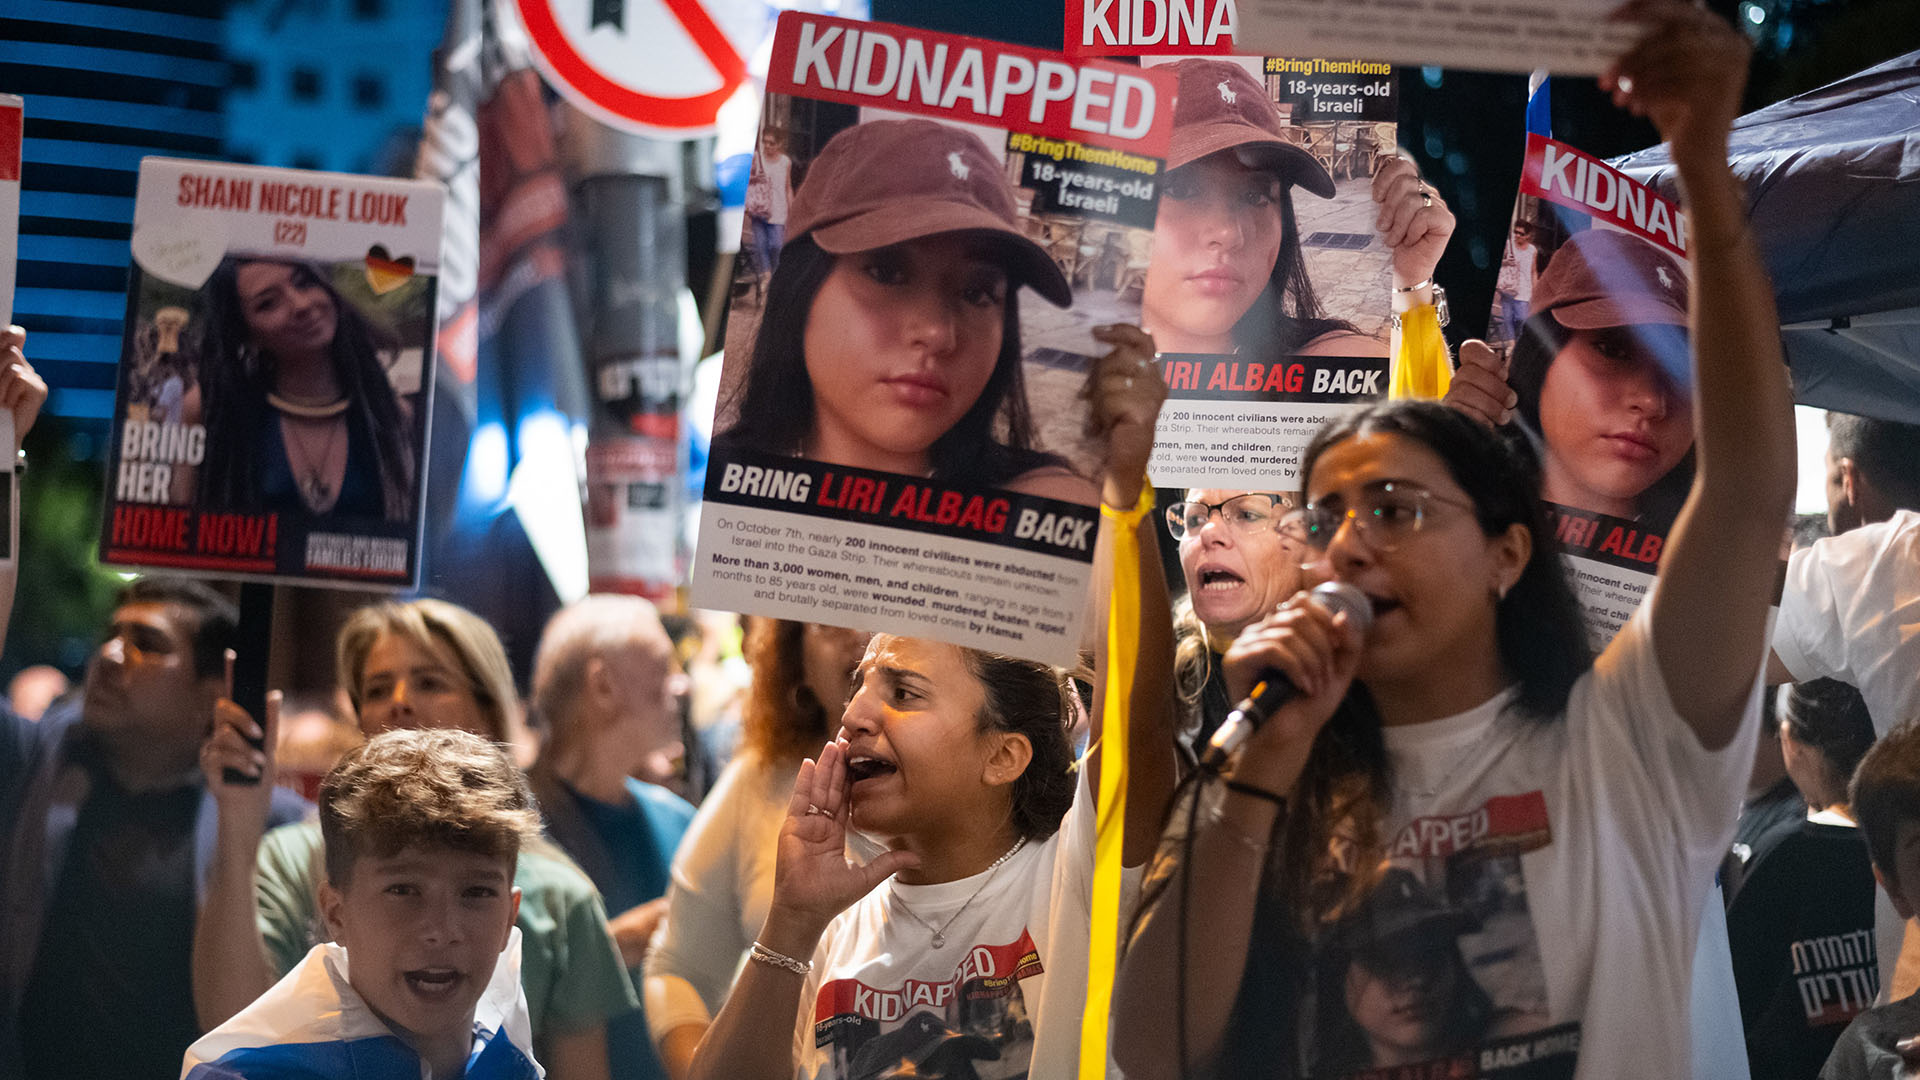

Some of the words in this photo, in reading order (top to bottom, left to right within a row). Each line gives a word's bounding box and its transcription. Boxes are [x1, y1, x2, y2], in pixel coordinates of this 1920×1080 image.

[793, 22, 1156, 140] KIDNAPPED
[1266, 58, 1391, 75] #BringThemHome
[1288, 81, 1390, 98] 18-years-old
[1313, 98, 1363, 113] Israeli
[1010, 134, 1157, 175] #BringThemHome
[1032, 162, 1154, 200] 18-years-old
[178, 174, 252, 210] SHANI
[259, 180, 342, 220] NICOLE
[348, 190, 408, 227] LOUK
[1058, 188, 1119, 214] Israeli
[274, 220, 307, 246] (22)
[1207, 362, 1305, 392] ALBAG
[1312, 369, 1382, 394] BACK
[1173, 412, 1190, 420] 200
[1193, 412, 1235, 421] innocent
[1237, 413, 1277, 423] civilians
[1197, 424, 1219, 433] Their
[1222, 425, 1280, 435] whereabouts
[122, 420, 207, 466] BRING
[1184, 442, 1208, 451] men,
[1211, 442, 1229, 451] and
[117, 462, 171, 504] HER
[1160, 465, 1205, 474] separated
[1208, 466, 1229, 474] from
[1232, 467, 1256, 475] loved
[1284, 468, 1296, 478] by
[720, 463, 812, 503] BRING
[817, 472, 888, 514] LIRI
[890, 485, 1010, 534] ALBAG
[1014, 508, 1094, 550] BACK
[112, 506, 190, 550] HOME
[197, 512, 278, 557] NOW!
[717, 518, 733, 530] On
[736, 520, 781, 536] October
[785, 527, 805, 541] 7th,
[808, 532, 842, 546] nearly
[845, 536, 866, 549] 200
[868, 541, 920, 557] innocent
[922, 550, 971, 566] civilians
[974, 559, 1001, 571] were
[712, 553, 740, 566] More
[744, 557, 769, 570] than
[773, 562, 804, 575] 3,000
[807, 568, 852, 583] women,
[855, 574, 883, 588] men,
[887, 580, 909, 591] and
[732, 535, 762, 549] Israel
[765, 540, 785, 552] into
[788, 544, 805, 555] the
[808, 545, 838, 560] Gaza
[874, 555, 899, 568] Their
[903, 560, 972, 580] whereabouts
[712, 570, 753, 583] months
[755, 575, 766, 584] to
[769, 576, 783, 587] 85
[786, 579, 816, 591] years
[843, 588, 869, 599] were
[1577, 570, 1621, 588] innocent
[754, 589, 775, 600] and
[778, 591, 819, 608] brutally
[822, 599, 878, 616] separated
[880, 605, 905, 618] from
[908, 609, 938, 624] loved
[969, 621, 983, 635] by
[1589, 605, 1608, 616] and
